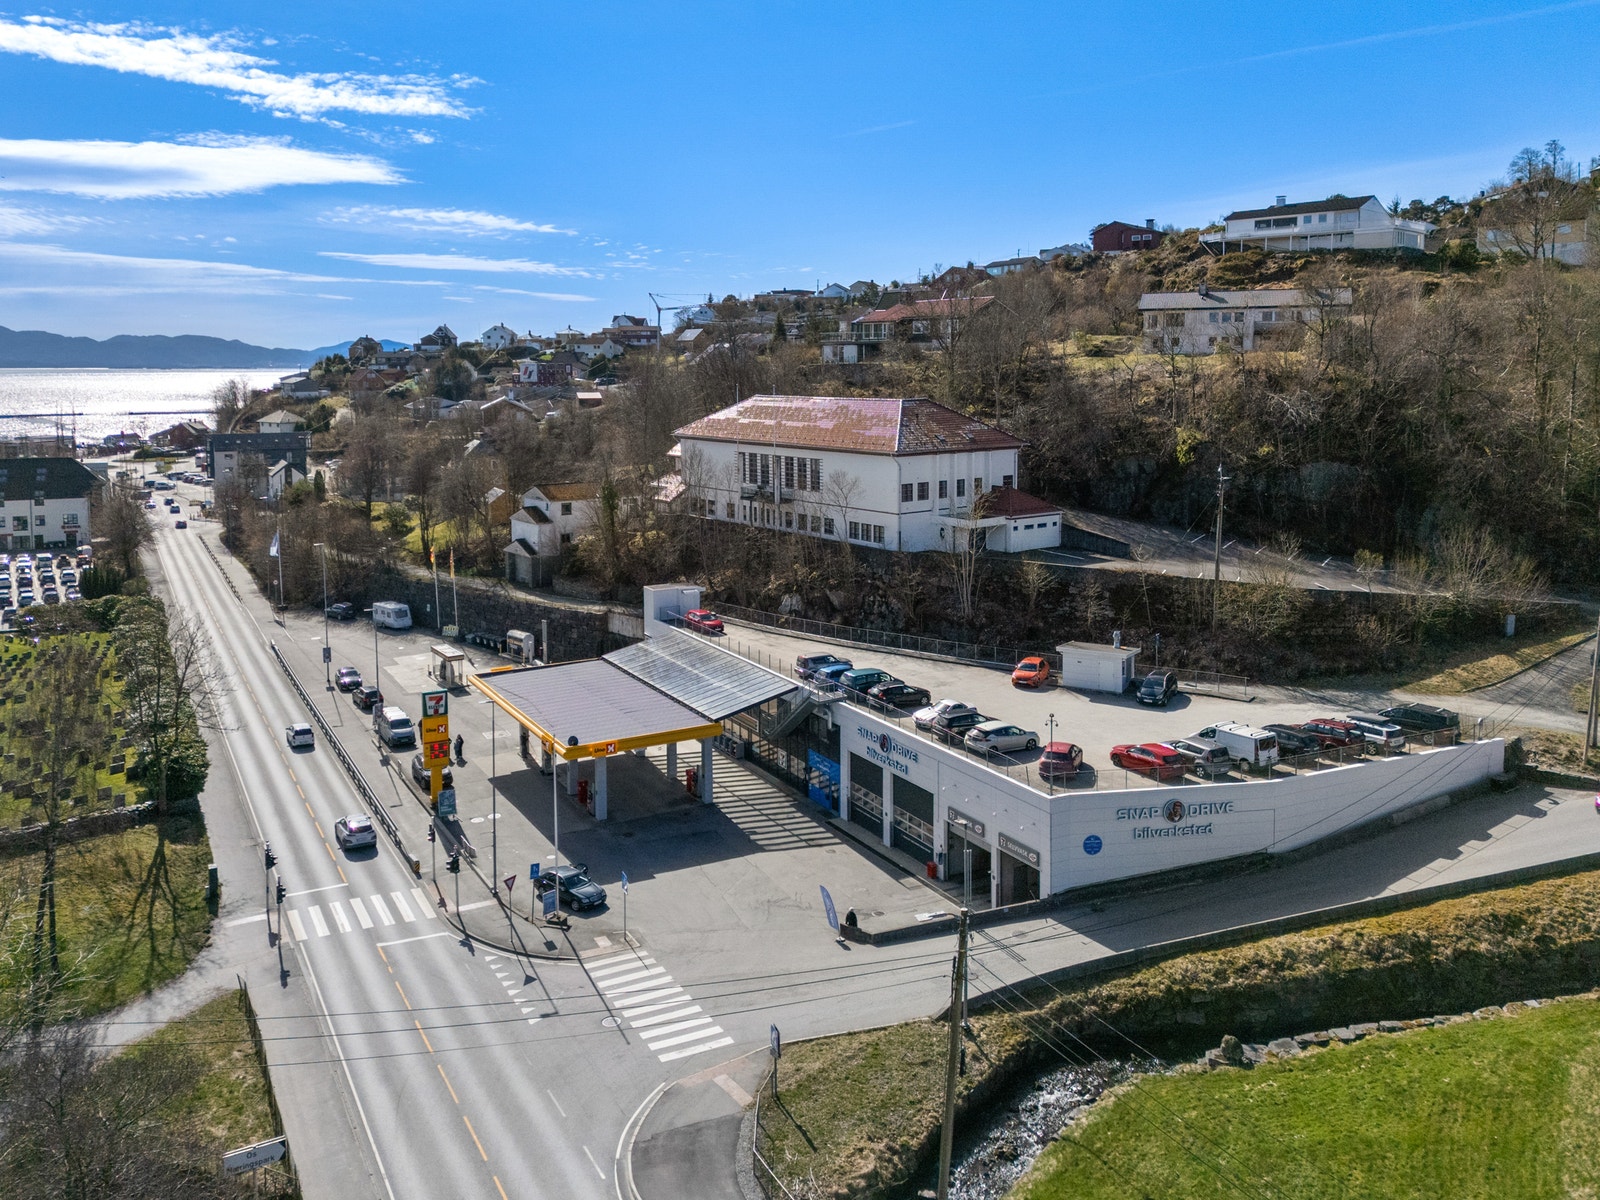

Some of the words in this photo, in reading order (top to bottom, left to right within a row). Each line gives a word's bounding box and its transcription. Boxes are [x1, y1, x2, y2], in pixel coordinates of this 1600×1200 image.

[857, 726, 879, 743] SNAP
[892, 742, 919, 763] DRIVE
[866, 746, 909, 775] bilverksted
[1116, 808, 1160, 821] SNAP
[1188, 801, 1235, 817] DRIVE
[1133, 823, 1213, 840] bilverksted
[246, 1151, 257, 1159] Os
